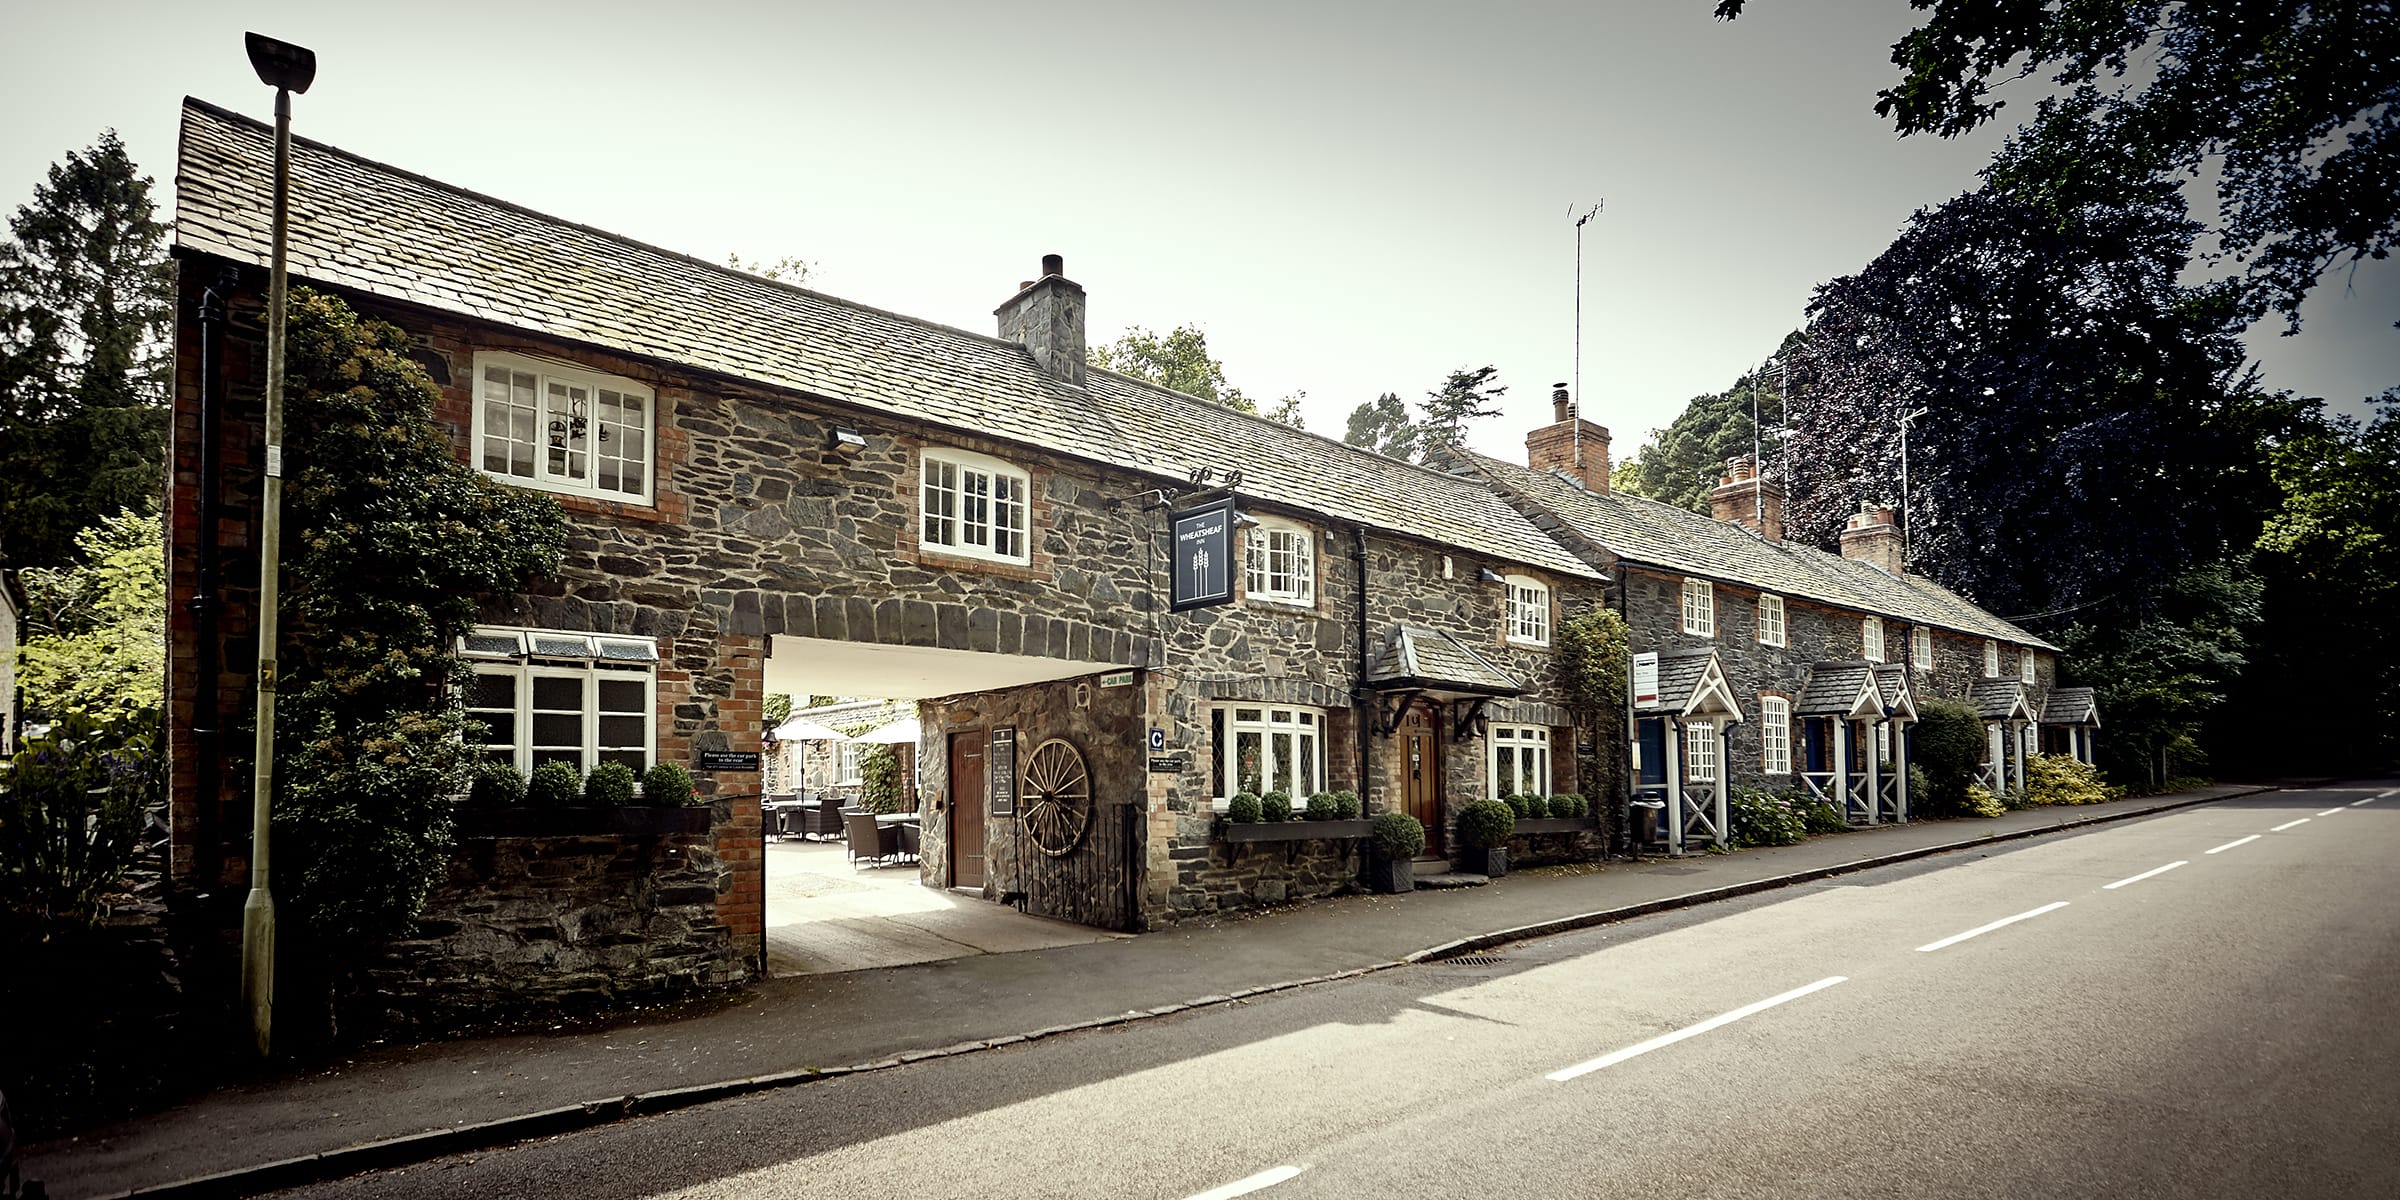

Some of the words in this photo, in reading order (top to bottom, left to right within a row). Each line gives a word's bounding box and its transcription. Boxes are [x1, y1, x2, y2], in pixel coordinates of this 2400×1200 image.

[1196, 521, 1205, 529] THE
[1179, 524, 1223, 542] WHEATSHEAF
[262, 669, 273, 680] 7
